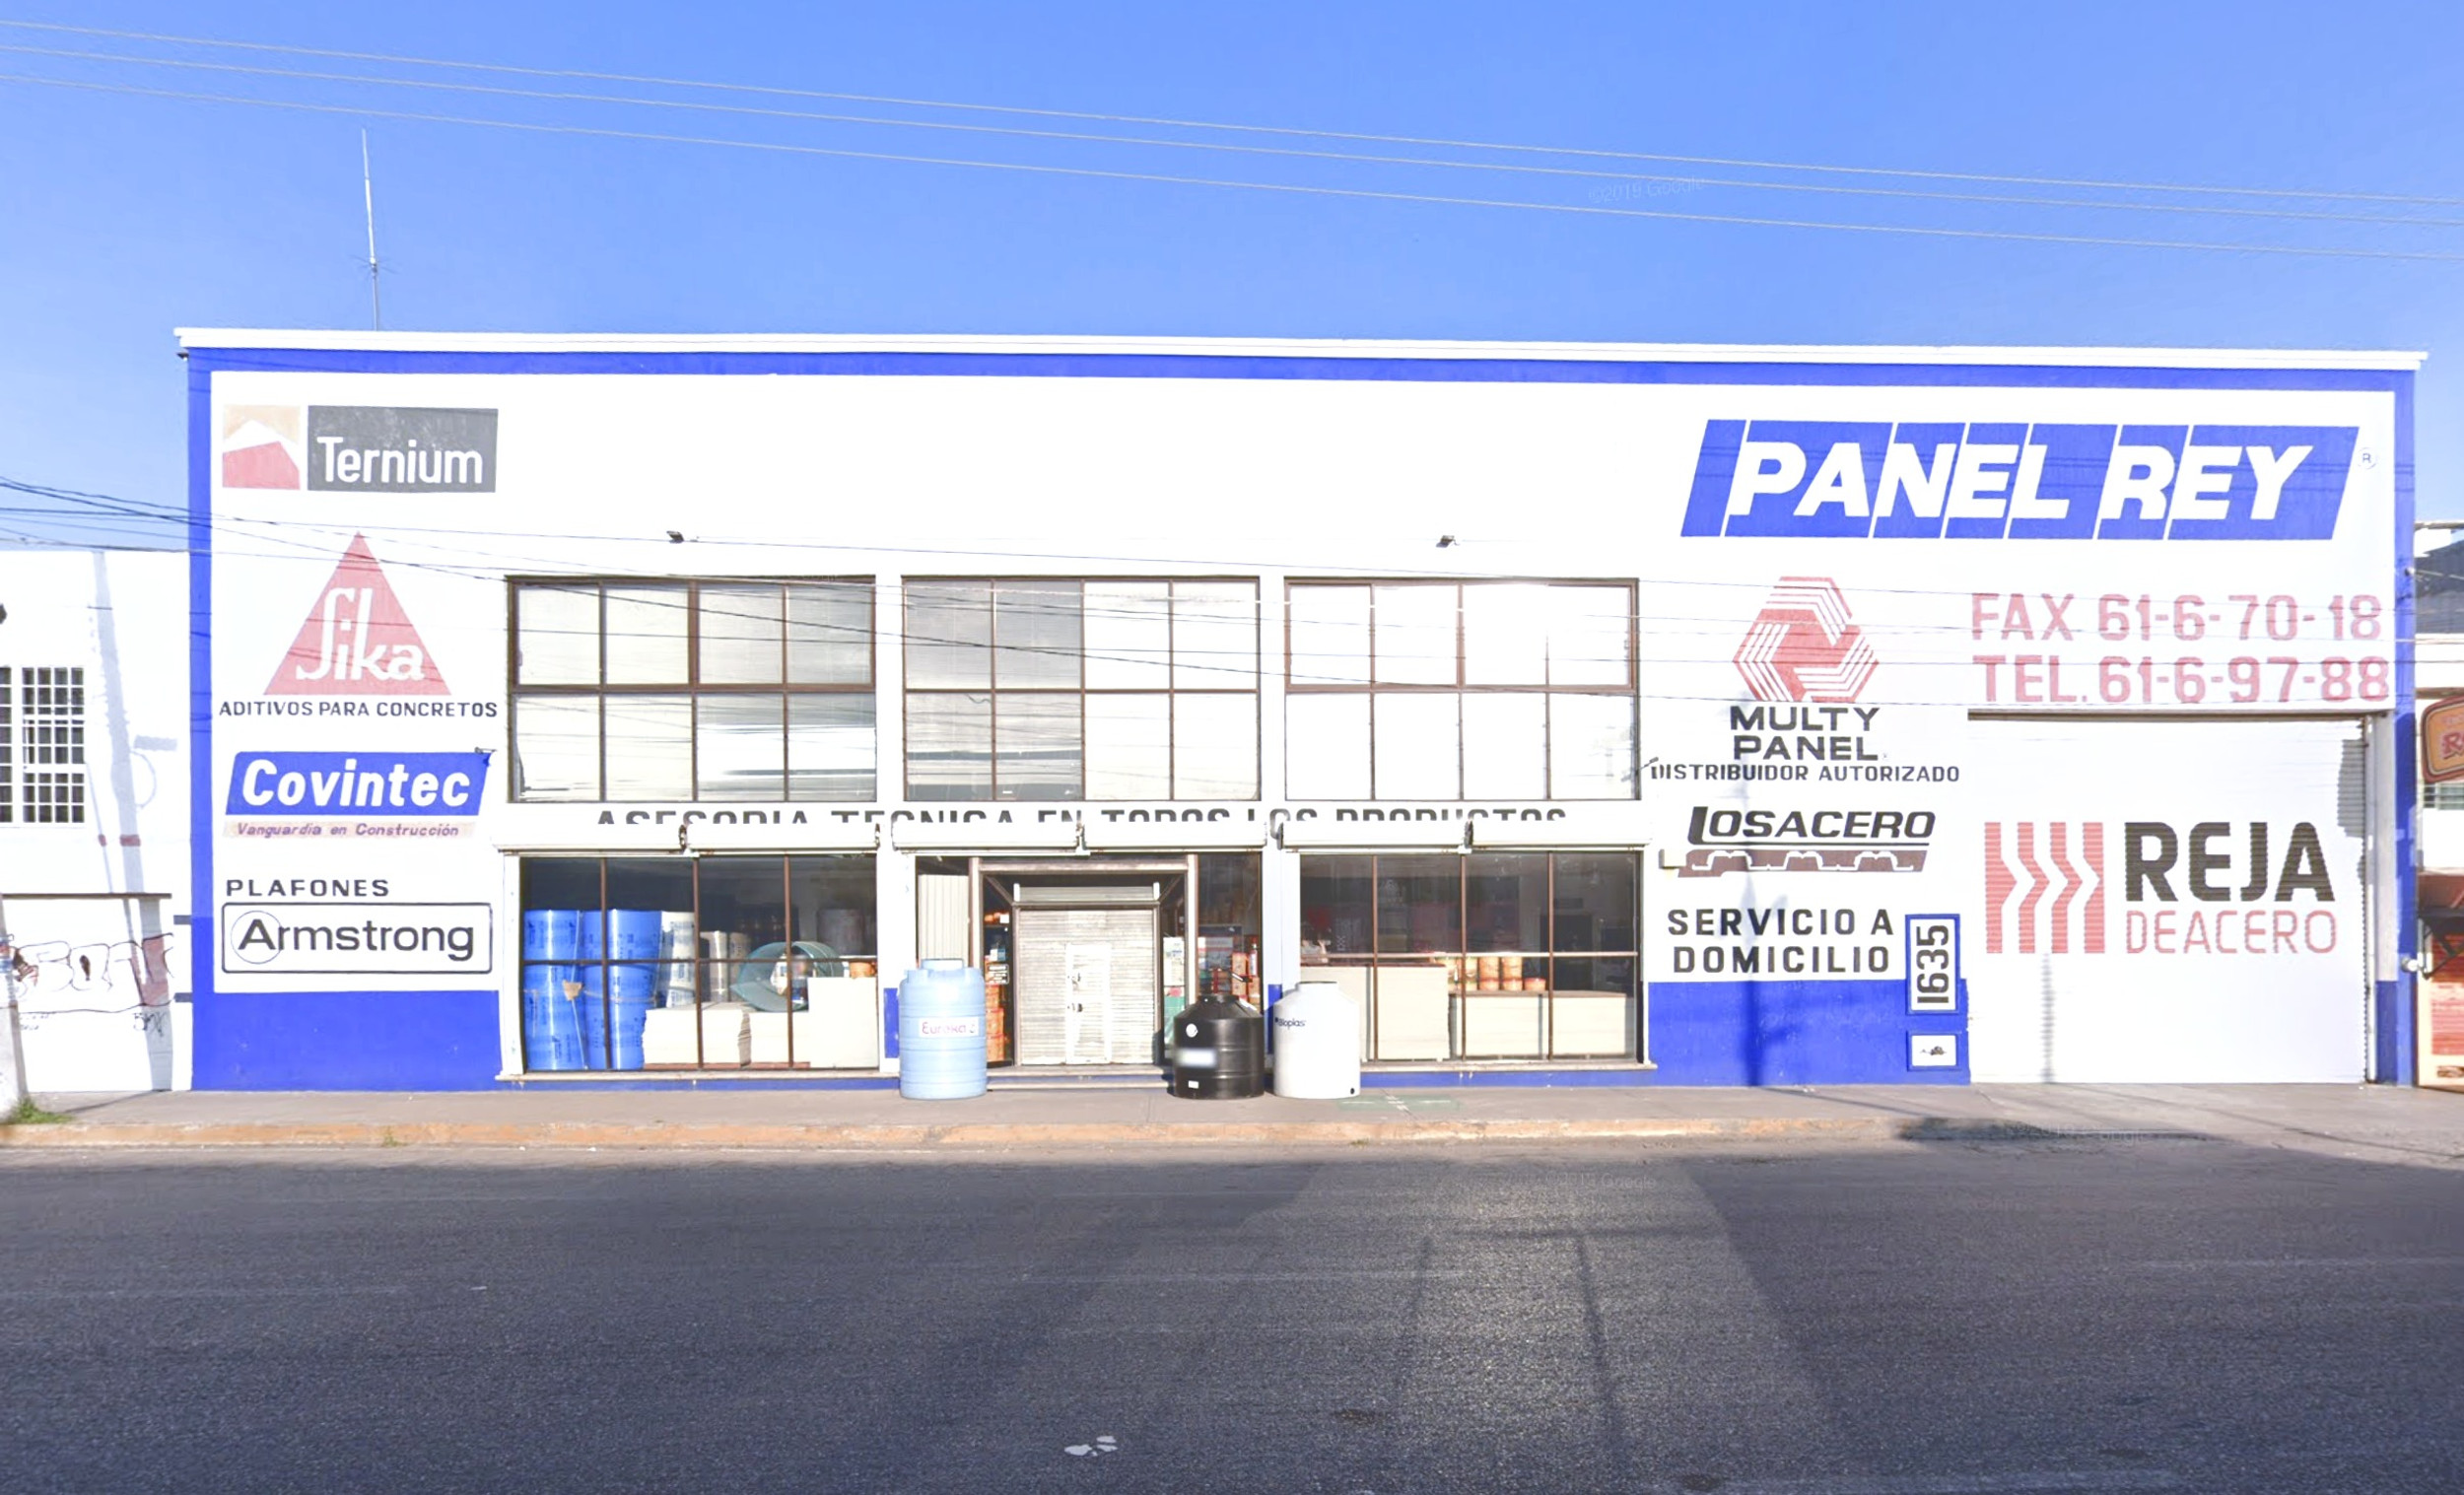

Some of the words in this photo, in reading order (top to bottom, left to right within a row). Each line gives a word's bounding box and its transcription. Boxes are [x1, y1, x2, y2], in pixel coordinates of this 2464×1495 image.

[316, 437, 483, 483] Ternium
[1729, 441, 2071, 519] PANEL
[2099, 443, 2316, 520] REY
[296, 587, 425, 681] Sika
[1971, 593, 2074, 641] FAX
[1972, 655, 2087, 703] TEL.
[219, 702, 312, 716] ADITIVOS
[319, 702, 370, 716] PARA
[376, 702, 498, 717] CONCRETOS
[1730, 706, 1880, 731] MULTY
[1734, 735, 1879, 760] PANEL
[242, 758, 470, 807] Covintec
[1651, 763, 1809, 781] DISTRIBUIDOR
[1819, 765, 1960, 782] AUTORIZADO
[238, 823, 322, 839] Vanguardia
[330, 826, 347, 836] en
[355, 823, 459, 837] Construcción
[1687, 806, 1937, 845] LOSACERO
[2125, 821, 2336, 902] REJA
[226, 879, 389, 897] PLAFONES
[238, 919, 474, 962] Armstrong
[1668, 909, 1856, 936] SERVICIO
[1871, 909, 1894, 935] A
[2125, 911, 2337, 954] DEACERO
[1674, 946, 1889, 973] DOMICILIO
[1916, 924, 1950, 1003] 1635
